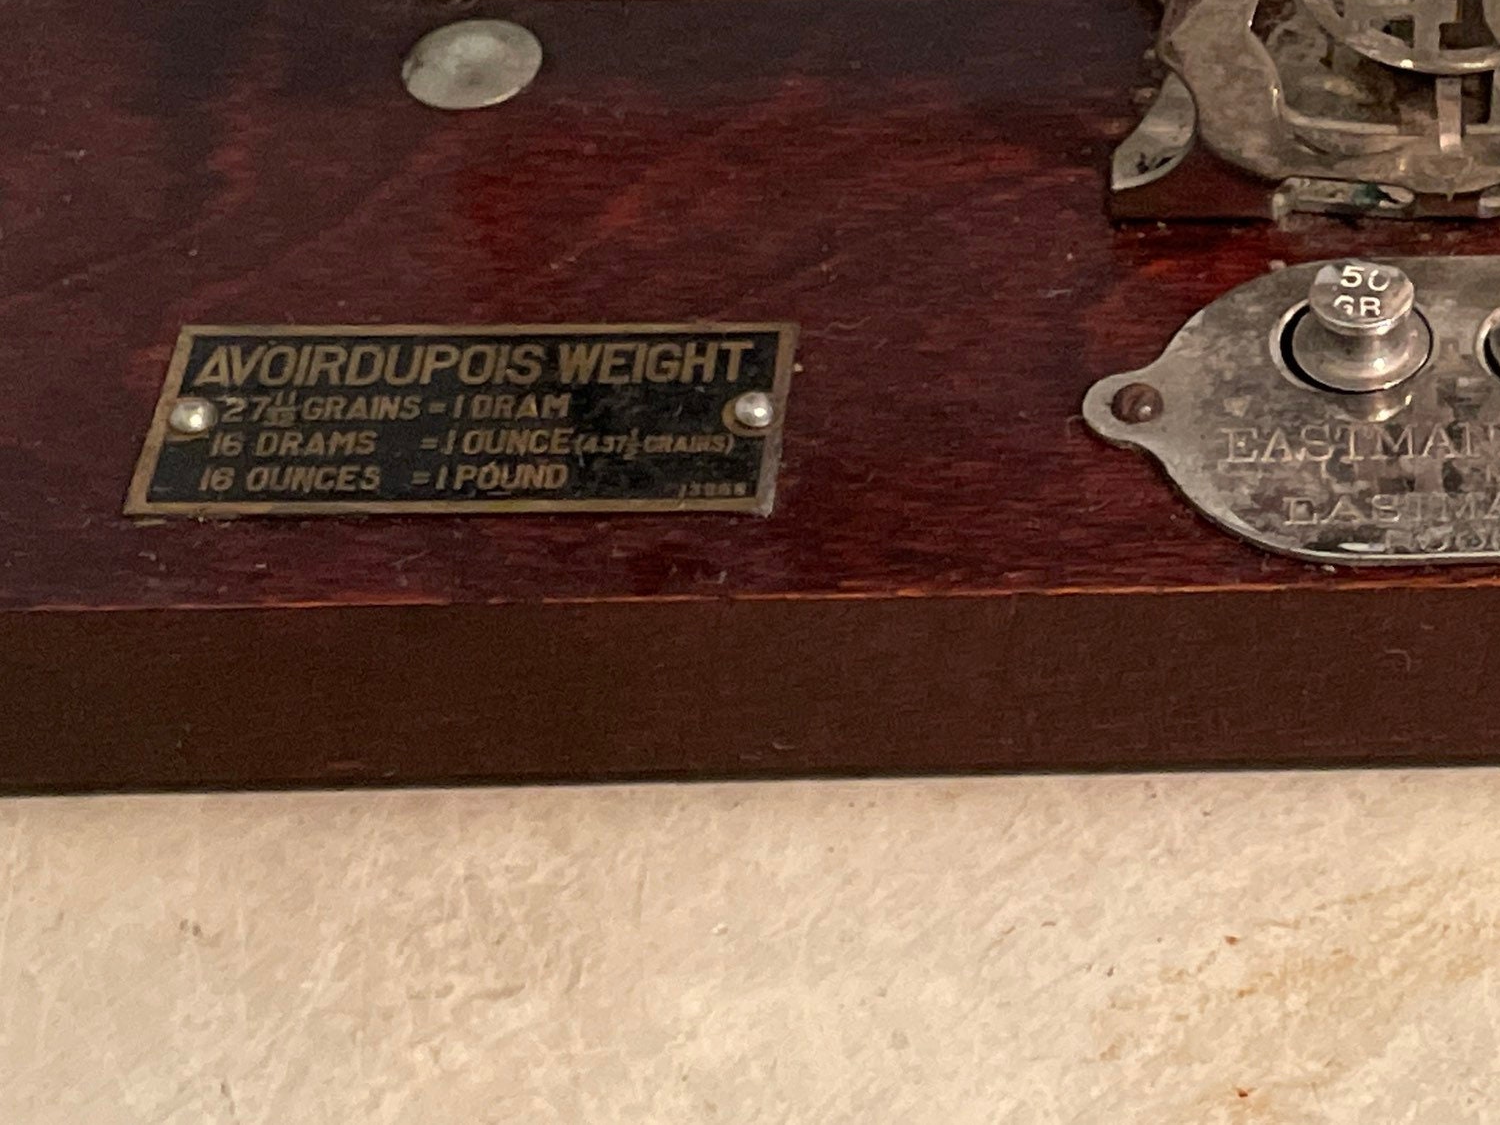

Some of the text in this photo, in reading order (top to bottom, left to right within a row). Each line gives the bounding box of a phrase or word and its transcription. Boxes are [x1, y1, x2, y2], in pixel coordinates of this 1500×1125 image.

[1340, 265, 1391, 292] 50
[193, 339, 756, 387] AVOIRDUPOIS WEIGHT
[303, 394, 422, 421] GRAINS
[470, 393, 572, 420] DRAM
[211, 431, 245, 457] 16
[255, 430, 378, 457] DRAMS
[461, 426, 575, 455] OUNCE
[245, 465, 382, 493] OUNCES
[452, 461, 569, 492] POUND
